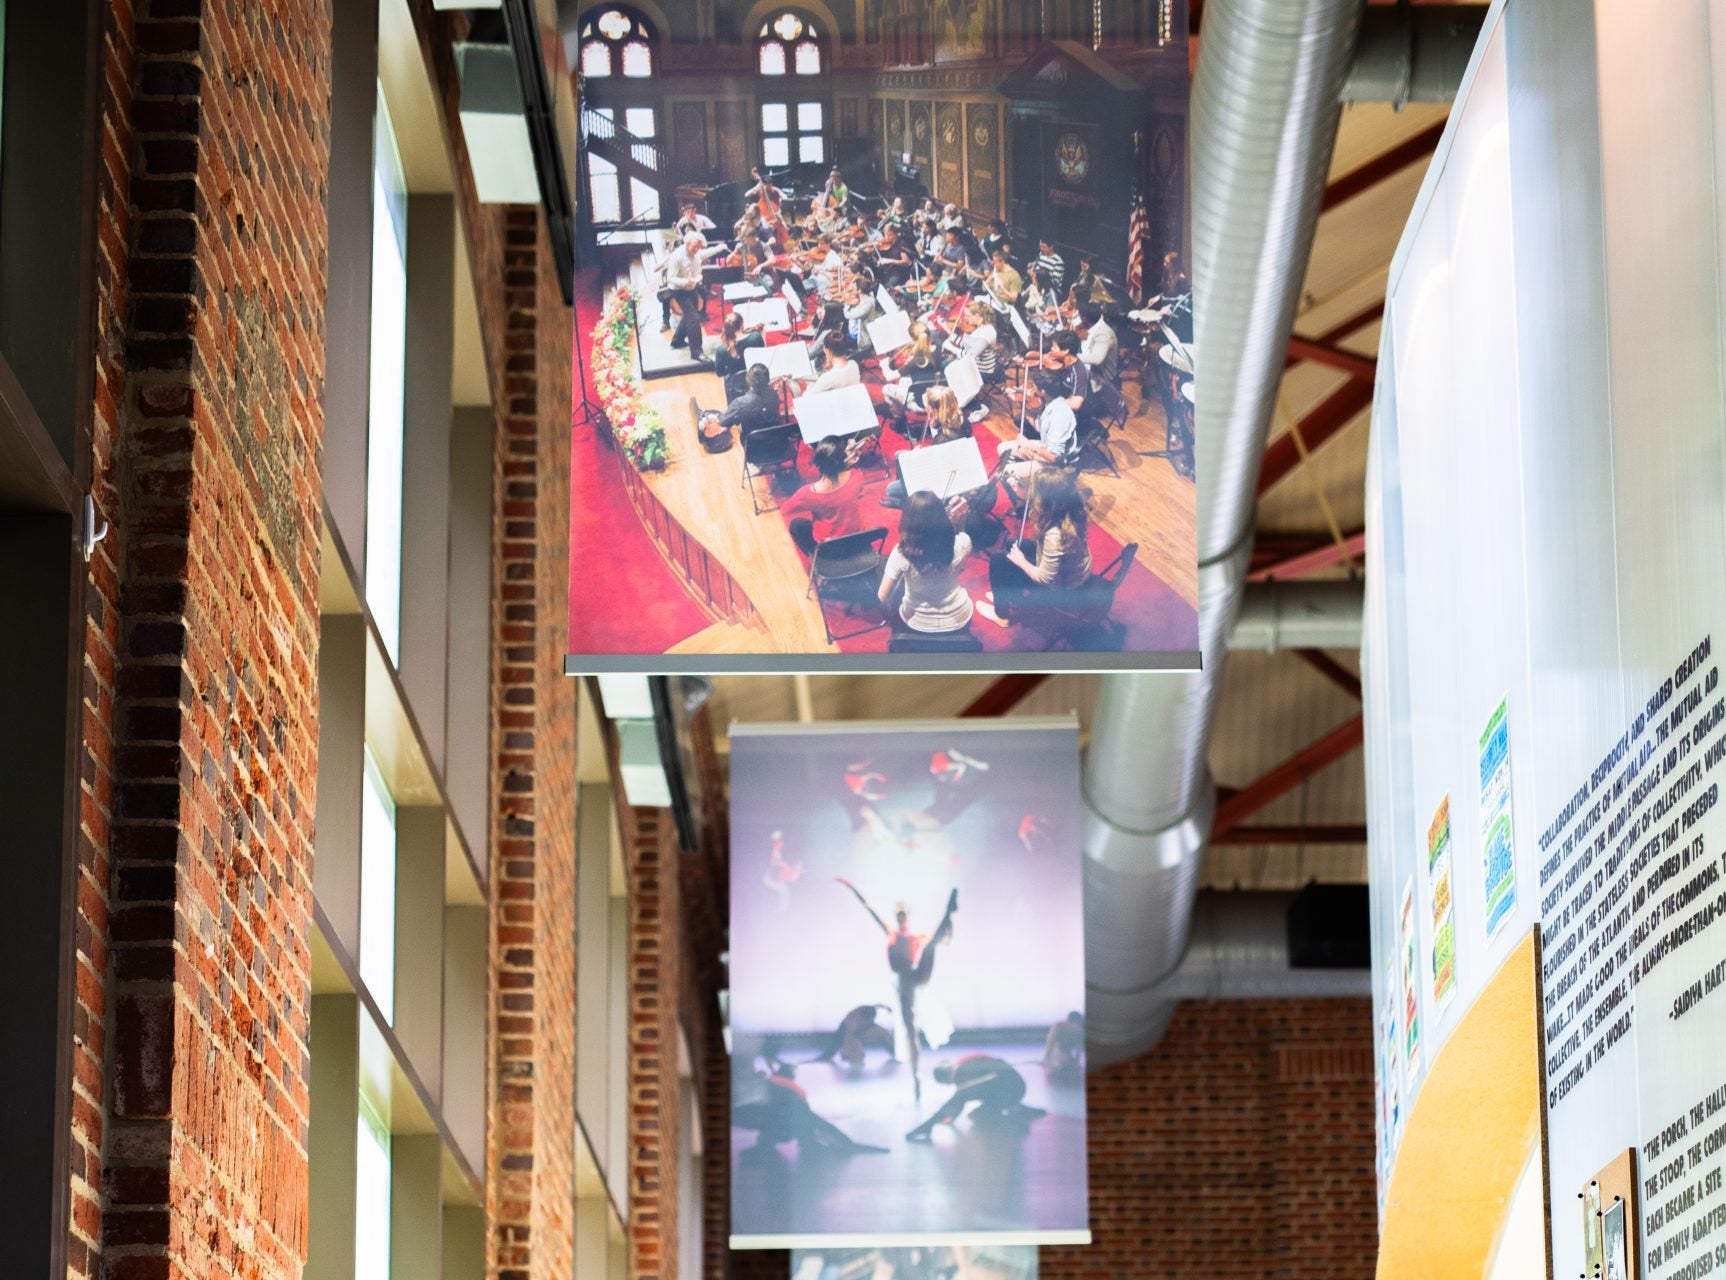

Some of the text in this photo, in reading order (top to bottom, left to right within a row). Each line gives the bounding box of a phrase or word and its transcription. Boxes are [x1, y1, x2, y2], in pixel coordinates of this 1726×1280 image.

[1631, 712, 1644, 744] AND
[1646, 677, 1672, 722] SHARED
[1675, 634, 1710, 689] CREATION
[1540, 851, 1560, 888] DEFINES
[1562, 834, 1573, 860] THE
[1574, 801, 1600, 847] PRACTICE
[1602, 791, 1610, 813] OF
[1613, 758, 1638, 802] MUTUAL
[1671, 683, 1702, 733] MUTUAL
[1705, 666, 1718, 700] AID
[1542, 697, 1724, 919] SOCIETY SURVIVED THE MIDDLE PASSAGE AND ITS ORIGINS
[1542, 915, 1561, 952] MIGHT
[1563, 904, 1570, 928] BE
[1572, 881, 1592, 917] TRACED
[1594, 869, 1603, 892] TO
[1642, 807, 1651, 833] OF
[1704, 732, 1726, 772] WHIC
[1544, 783, 1718, 983] FLOURISHED IN THE STATELESS SOCIETIES THAT PRECEDED
[1545, 833, 1704, 1014] THE BREACH OF THE ATLANTIC AND PERDURED IN ITS
[1576, 978, 1594, 1016] MADE
[1595, 956, 1614, 992] GOOD
[1616, 941, 1627, 970] THE
[1651, 904, 1660, 931] OF
[1662, 892, 1674, 920] THE
[1582, 1013, 1594, 1040] THE
[1628, 962, 1640, 990] THE
[1642, 891, 1726, 977] ALWAYS-MORE-THAN-O
[1704, 958, 1726, 995] HART
[1549, 1086, 1558, 1110] OF
[1558, 1060, 1584, 1101] EXISTING
[1586, 1050, 1592, 1072] IN
[1594, 1040, 1604, 1064] THE
[1662, 1114, 1688, 1152] PORCH,
[1690, 1100, 1704, 1130] THE
[1706, 1084, 1726, 1118] HALL
[1645, 1122, 1726, 1201] THE STOOP, THE CORN
[1646, 1166, 1722, 1237] EACH BECAME A SITE
[1648, 1245, 1662, 1273] FOR
[1664, 1226, 1690, 1263] NEWLY
